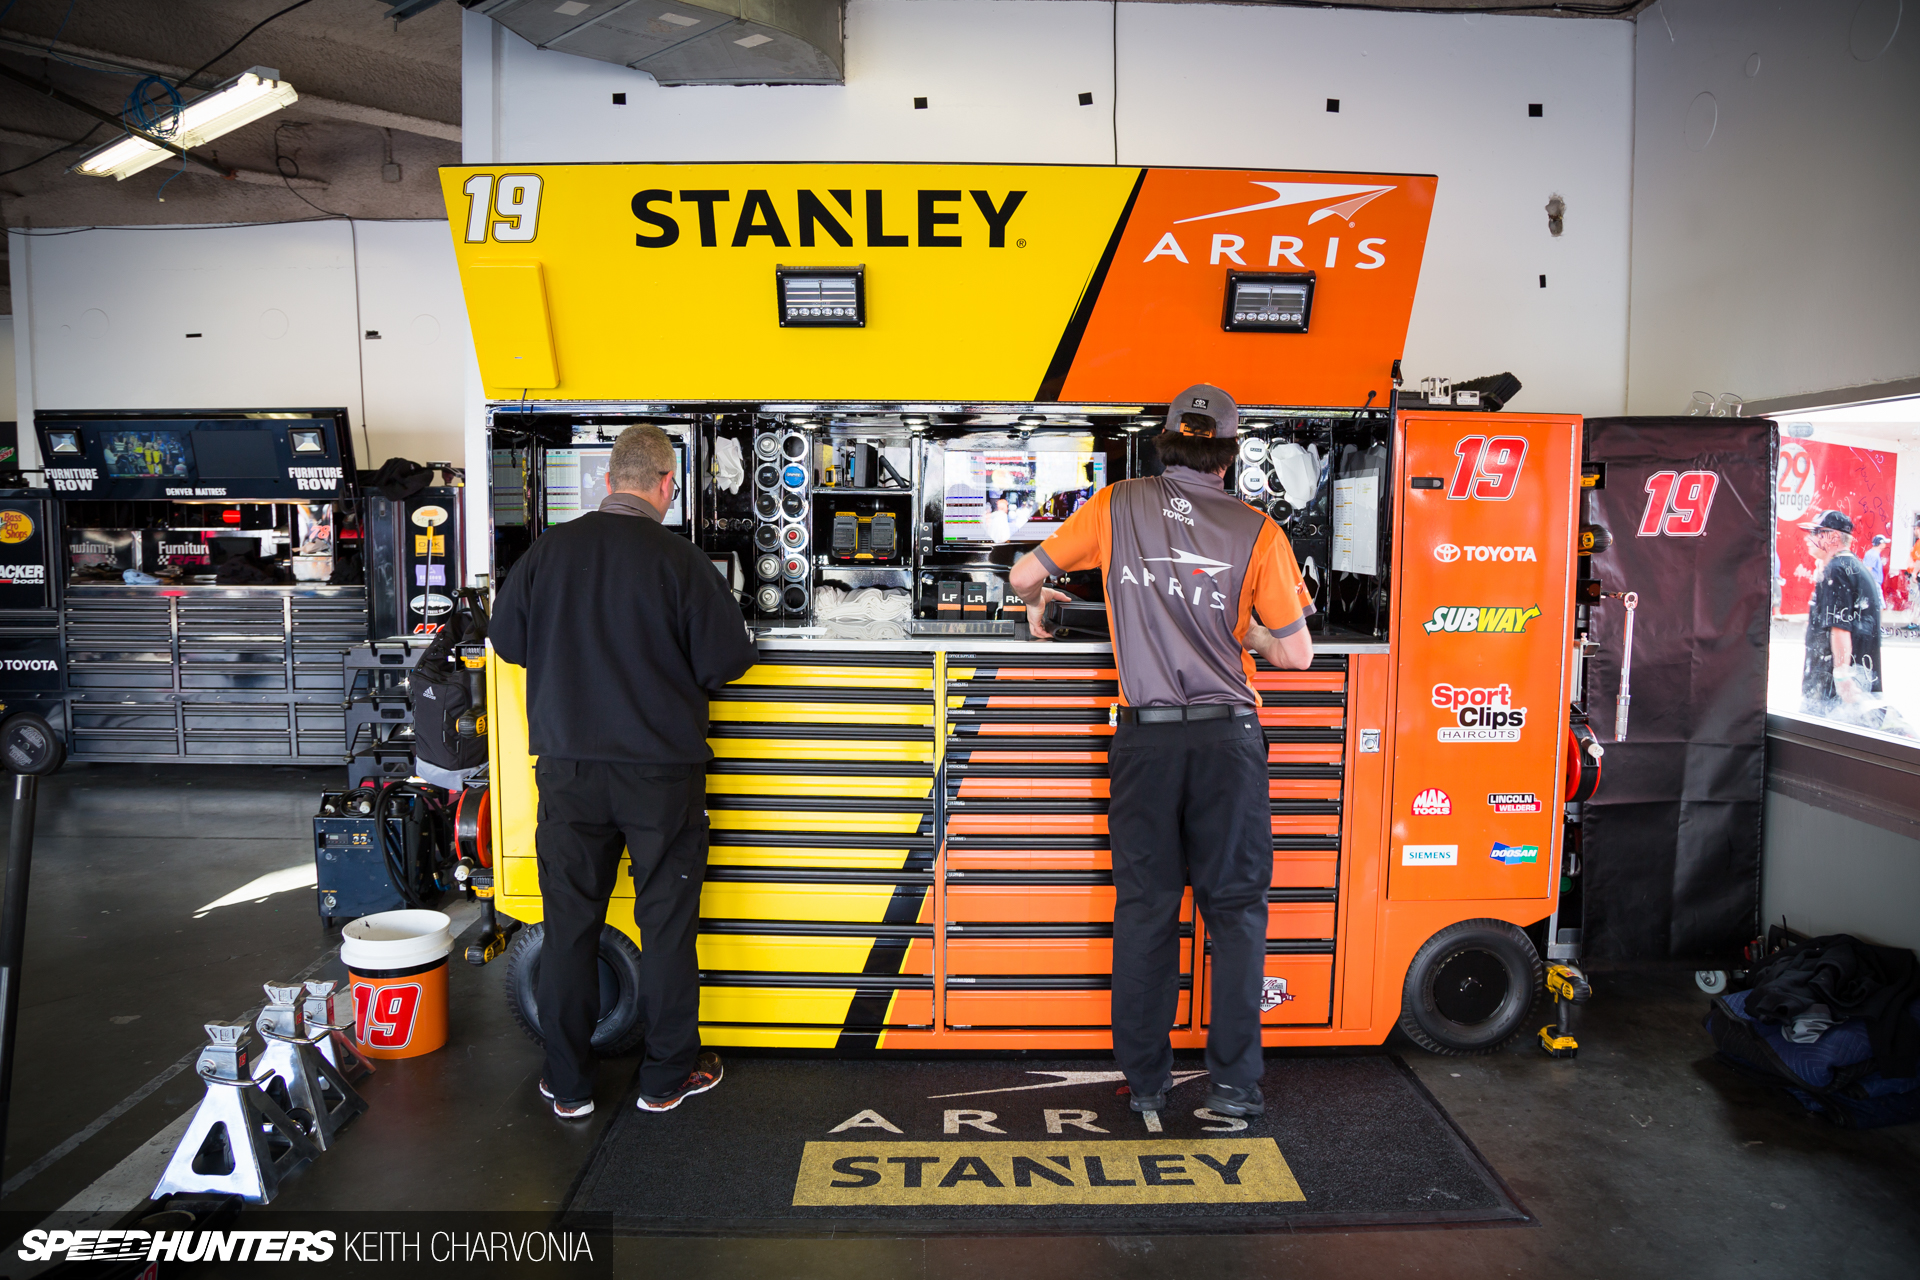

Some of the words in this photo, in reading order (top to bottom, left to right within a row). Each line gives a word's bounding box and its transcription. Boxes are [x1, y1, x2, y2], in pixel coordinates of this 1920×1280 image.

[463, 173, 543, 243] 19
[631, 188, 1028, 249] STANLEY
[1143, 232, 1387, 269] ARRIS
[45, 468, 99, 480] FURNITURE
[288, 467, 343, 479] FURNITURE
[1448, 435, 1529, 501] 19
[1778, 450, 1811, 493] 29
[54, 479, 93, 491] ROW
[297, 479, 337, 491] ROW
[165, 488, 193, 496] DENVER
[195, 488, 227, 496] MATTRESS
[1637, 470, 1719, 537] 19
[4, 512, 22, 522] Bass
[1162, 508, 1195, 527] TOYOTA
[5, 521, 19, 530] Pro
[5, 530, 28, 540] Shops
[1464, 545, 1537, 563] TOYOTA
[942, 593, 958, 602] LF
[967, 594, 984, 603] LR
[1423, 604, 1541, 635] SUBWAY
[4, 660, 58, 671] TOYOTA
[1433, 685, 1510, 711] Sport
[1458, 706, 1524, 730] Clips
[1442, 730, 1516, 739] HAIRCUTS
[1413, 789, 1450, 808] MAC
[1490, 795, 1533, 804] LINCOLN
[1413, 807, 1450, 815] TOOLS
[1499, 804, 1537, 812] WELDERS
[1409, 851, 1451, 860] SIEMENS
[1490, 849, 1537, 858] DOOSAN
[352, 981, 422, 1050] 19
[238, 1052, 247, 1068] 19
[826, 1108, 1249, 1134] ARRIS
[830, 1153, 1250, 1188] STANLEY
